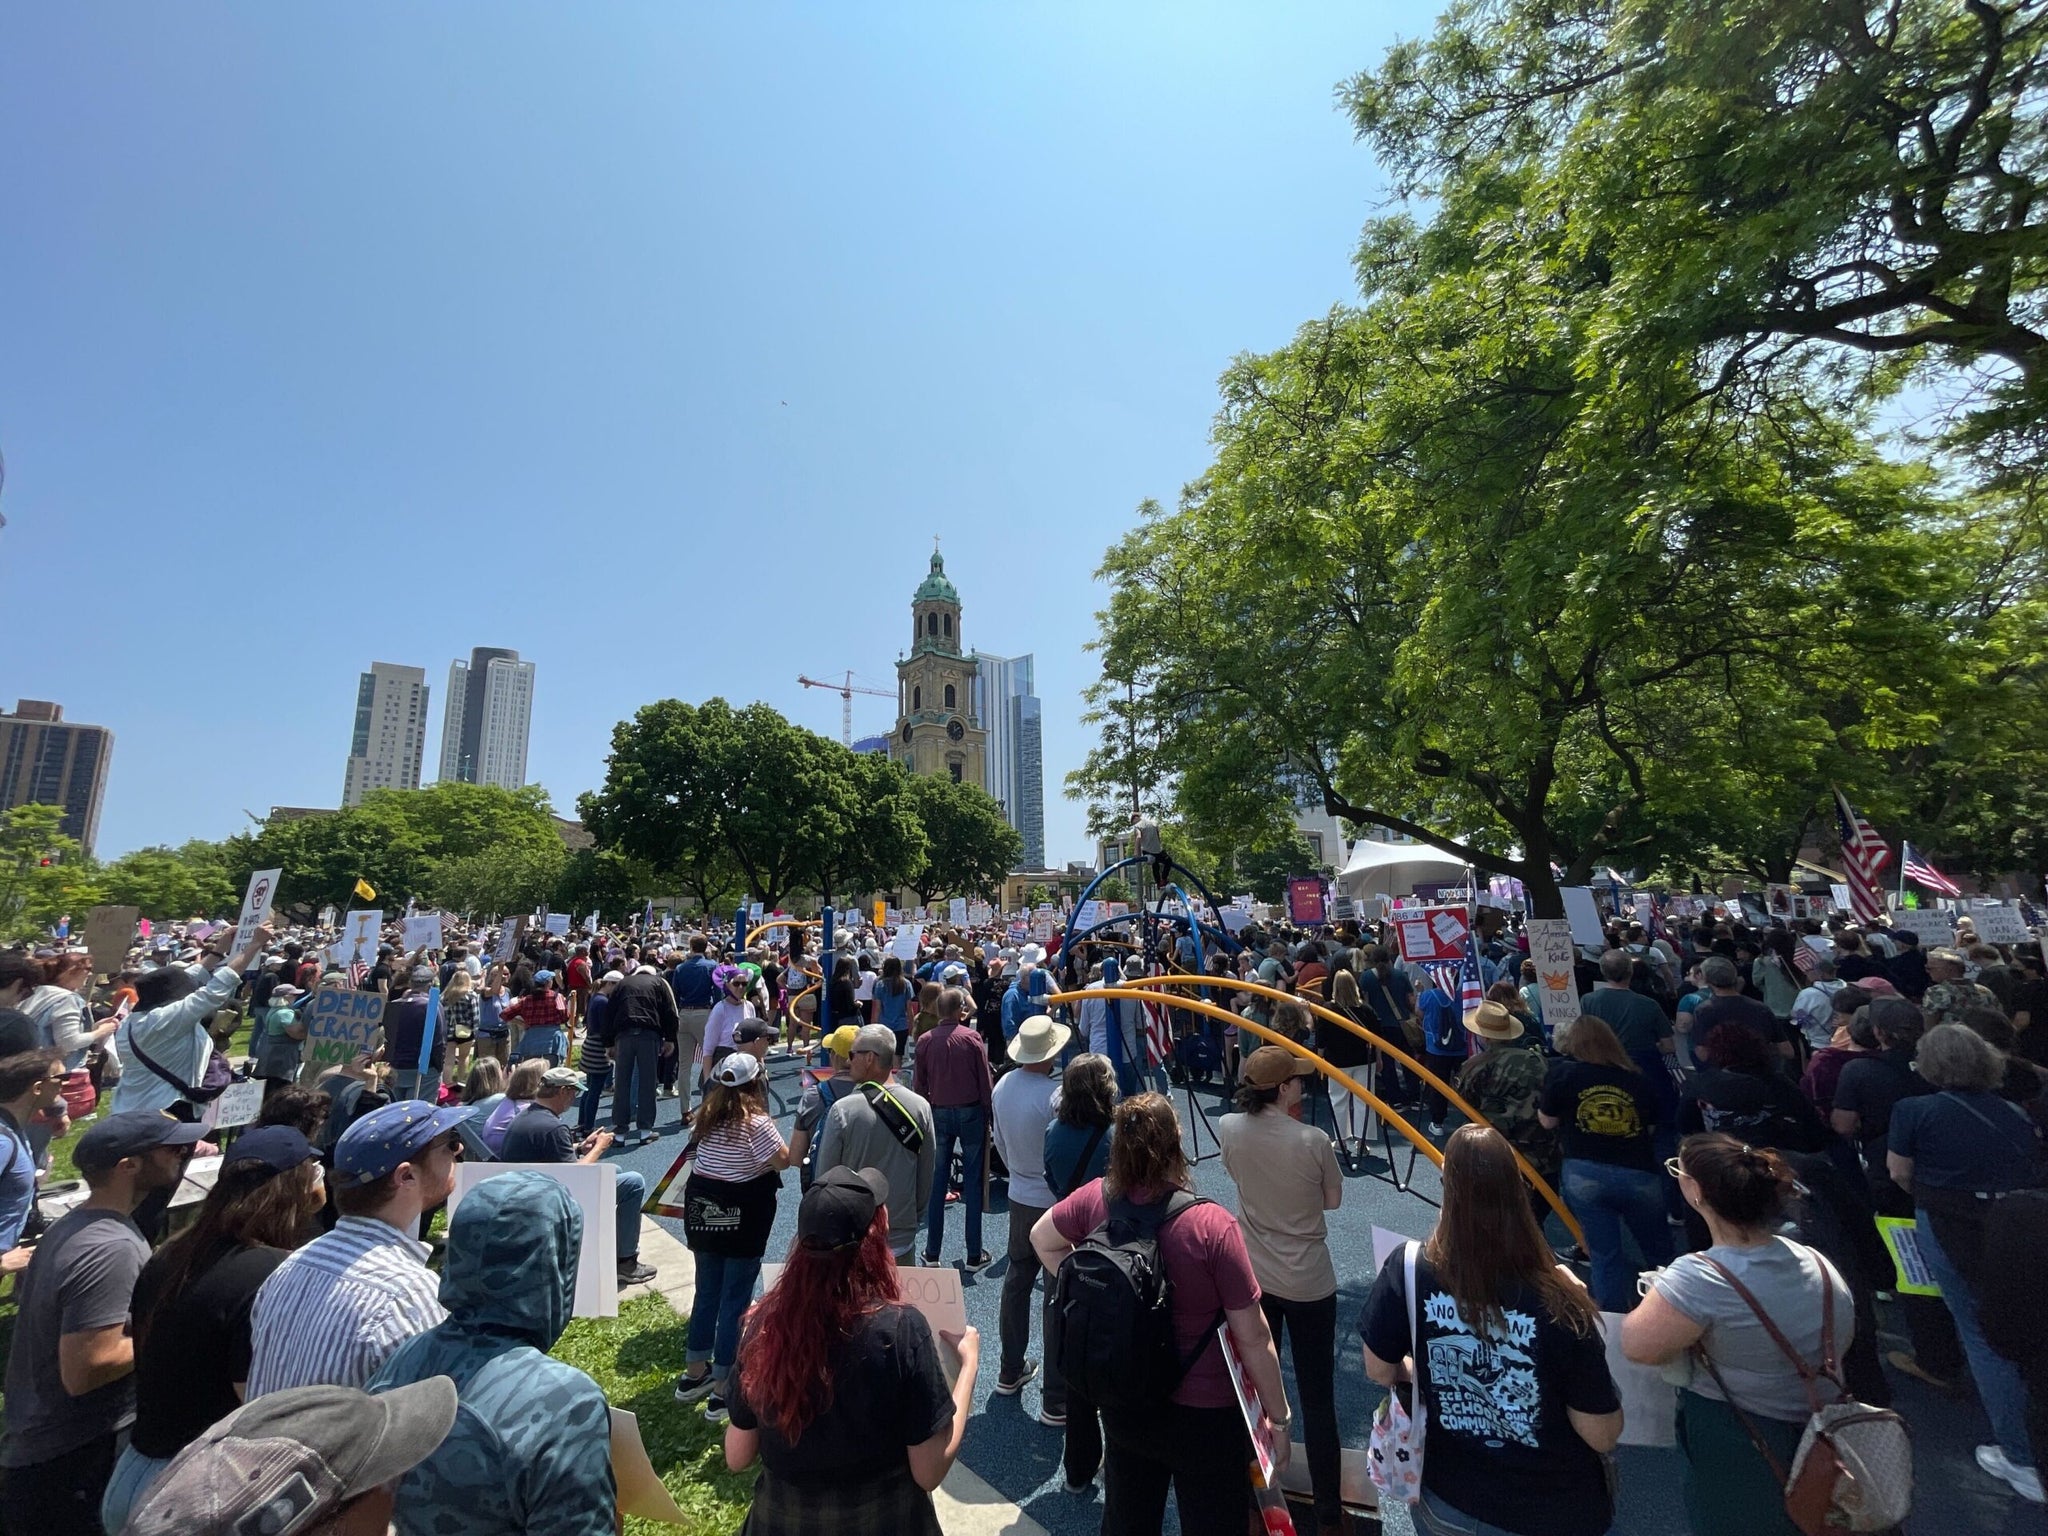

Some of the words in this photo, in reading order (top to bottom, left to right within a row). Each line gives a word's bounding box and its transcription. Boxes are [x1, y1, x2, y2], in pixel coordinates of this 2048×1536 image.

[317, 990, 382, 1020] DEMO
[1549, 991, 1570, 1004] NO
[1548, 1007, 1577, 1018] KINGS
[309, 1015, 377, 1042] CRACY
[1439, 1391, 1463, 1401] ICE
[1504, 1411, 1528, 1422] OUR
